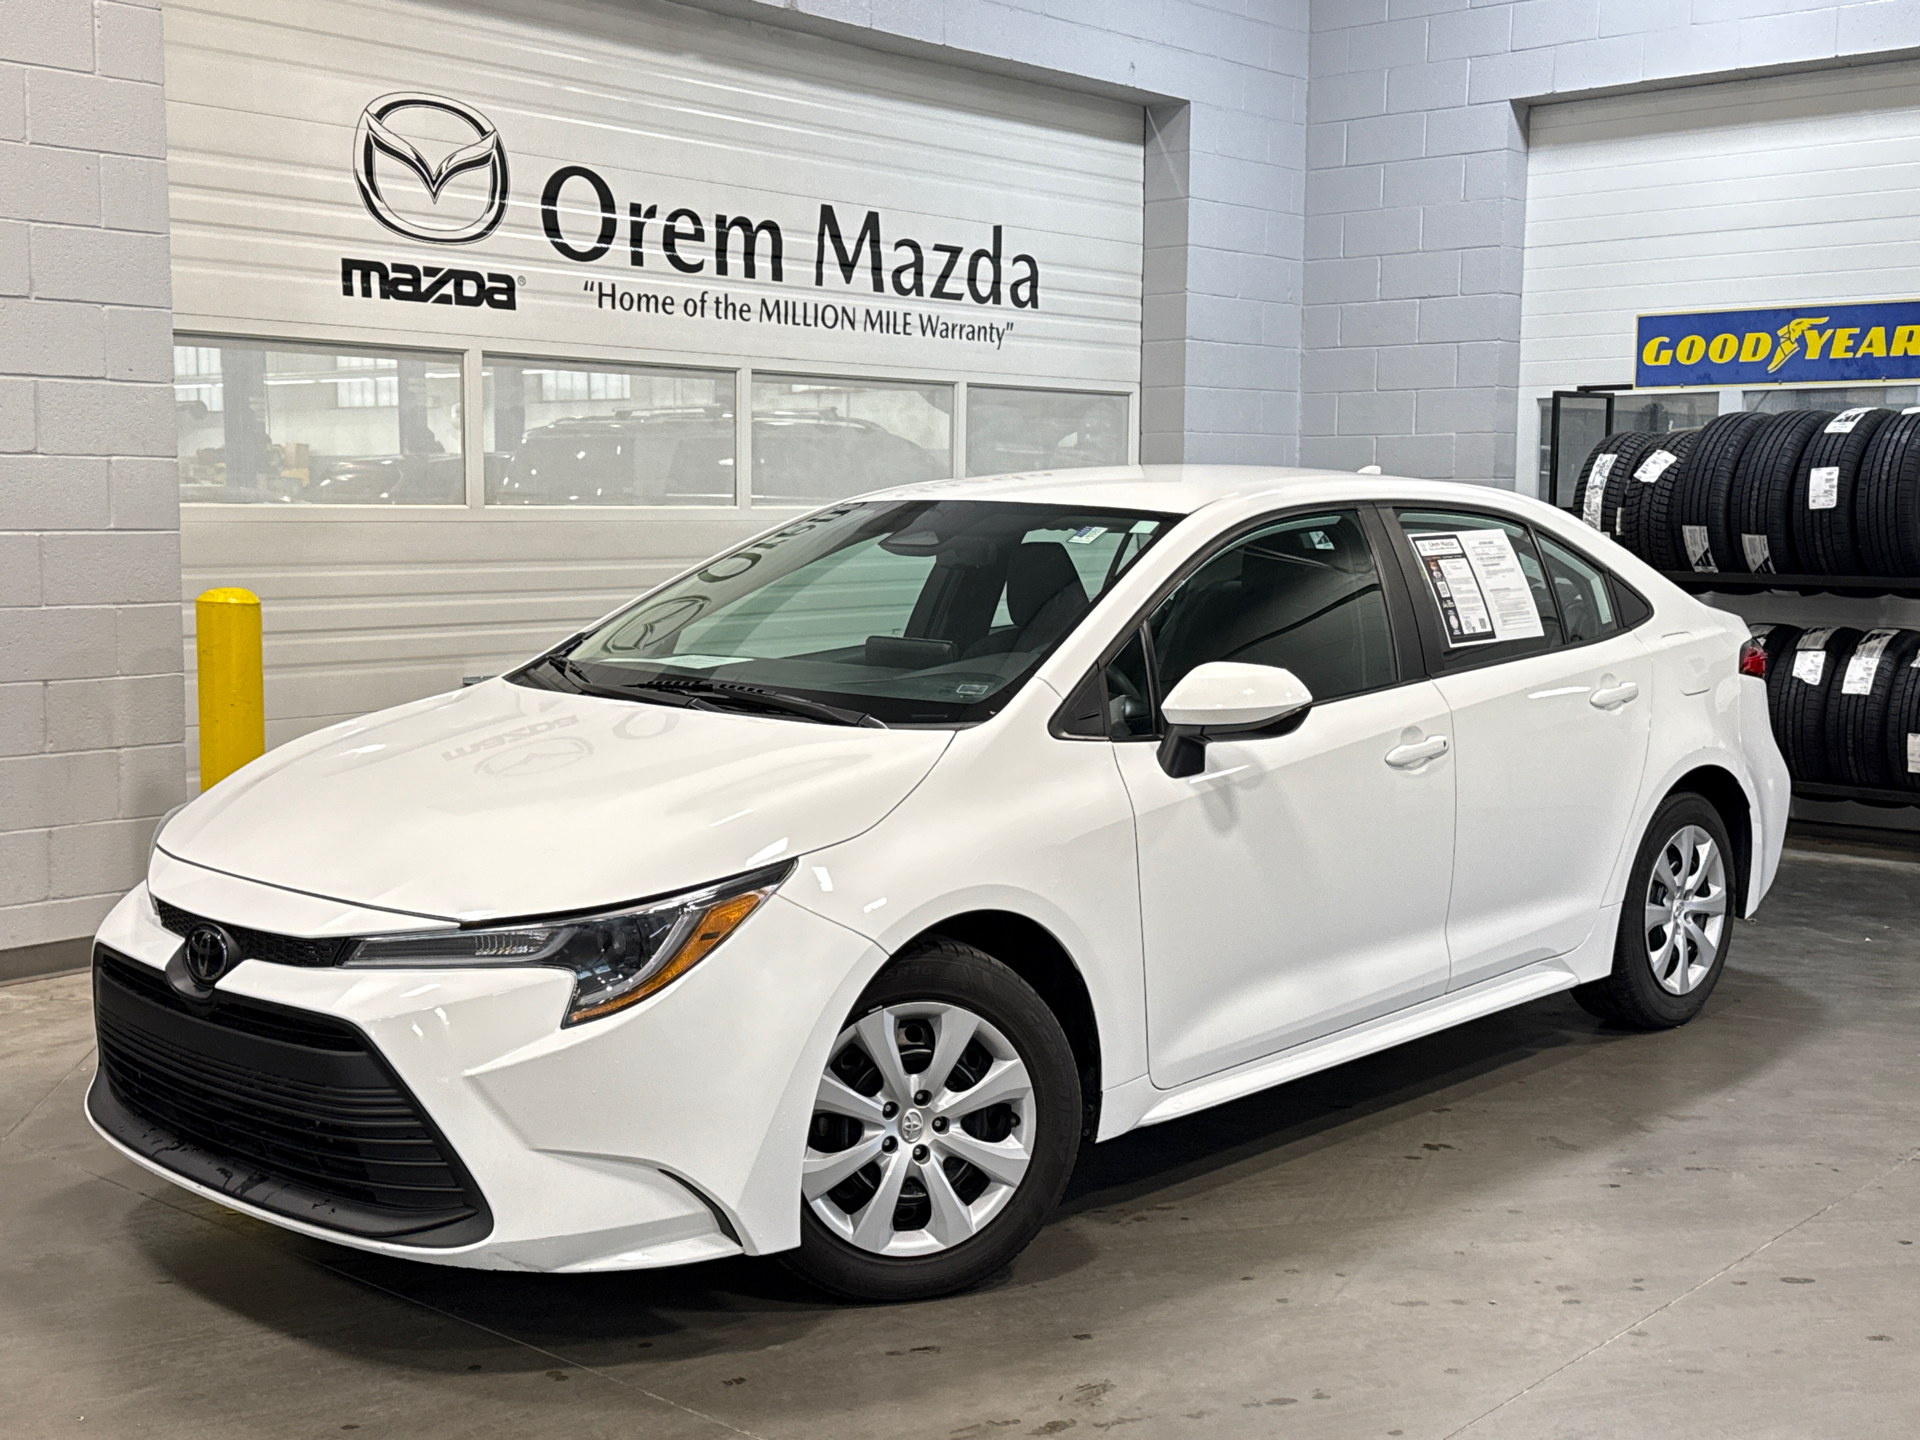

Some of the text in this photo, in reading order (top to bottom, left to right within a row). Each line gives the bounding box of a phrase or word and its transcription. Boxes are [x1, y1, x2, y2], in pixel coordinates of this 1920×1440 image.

[541, 165, 1039, 310] Orem Mazda
[341, 258, 517, 311] mazda
[683, 291, 709, 318] of
[714, 293, 752, 322] the
[759, 298, 856, 331] MILLION
[864, 308, 912, 336] MILE
